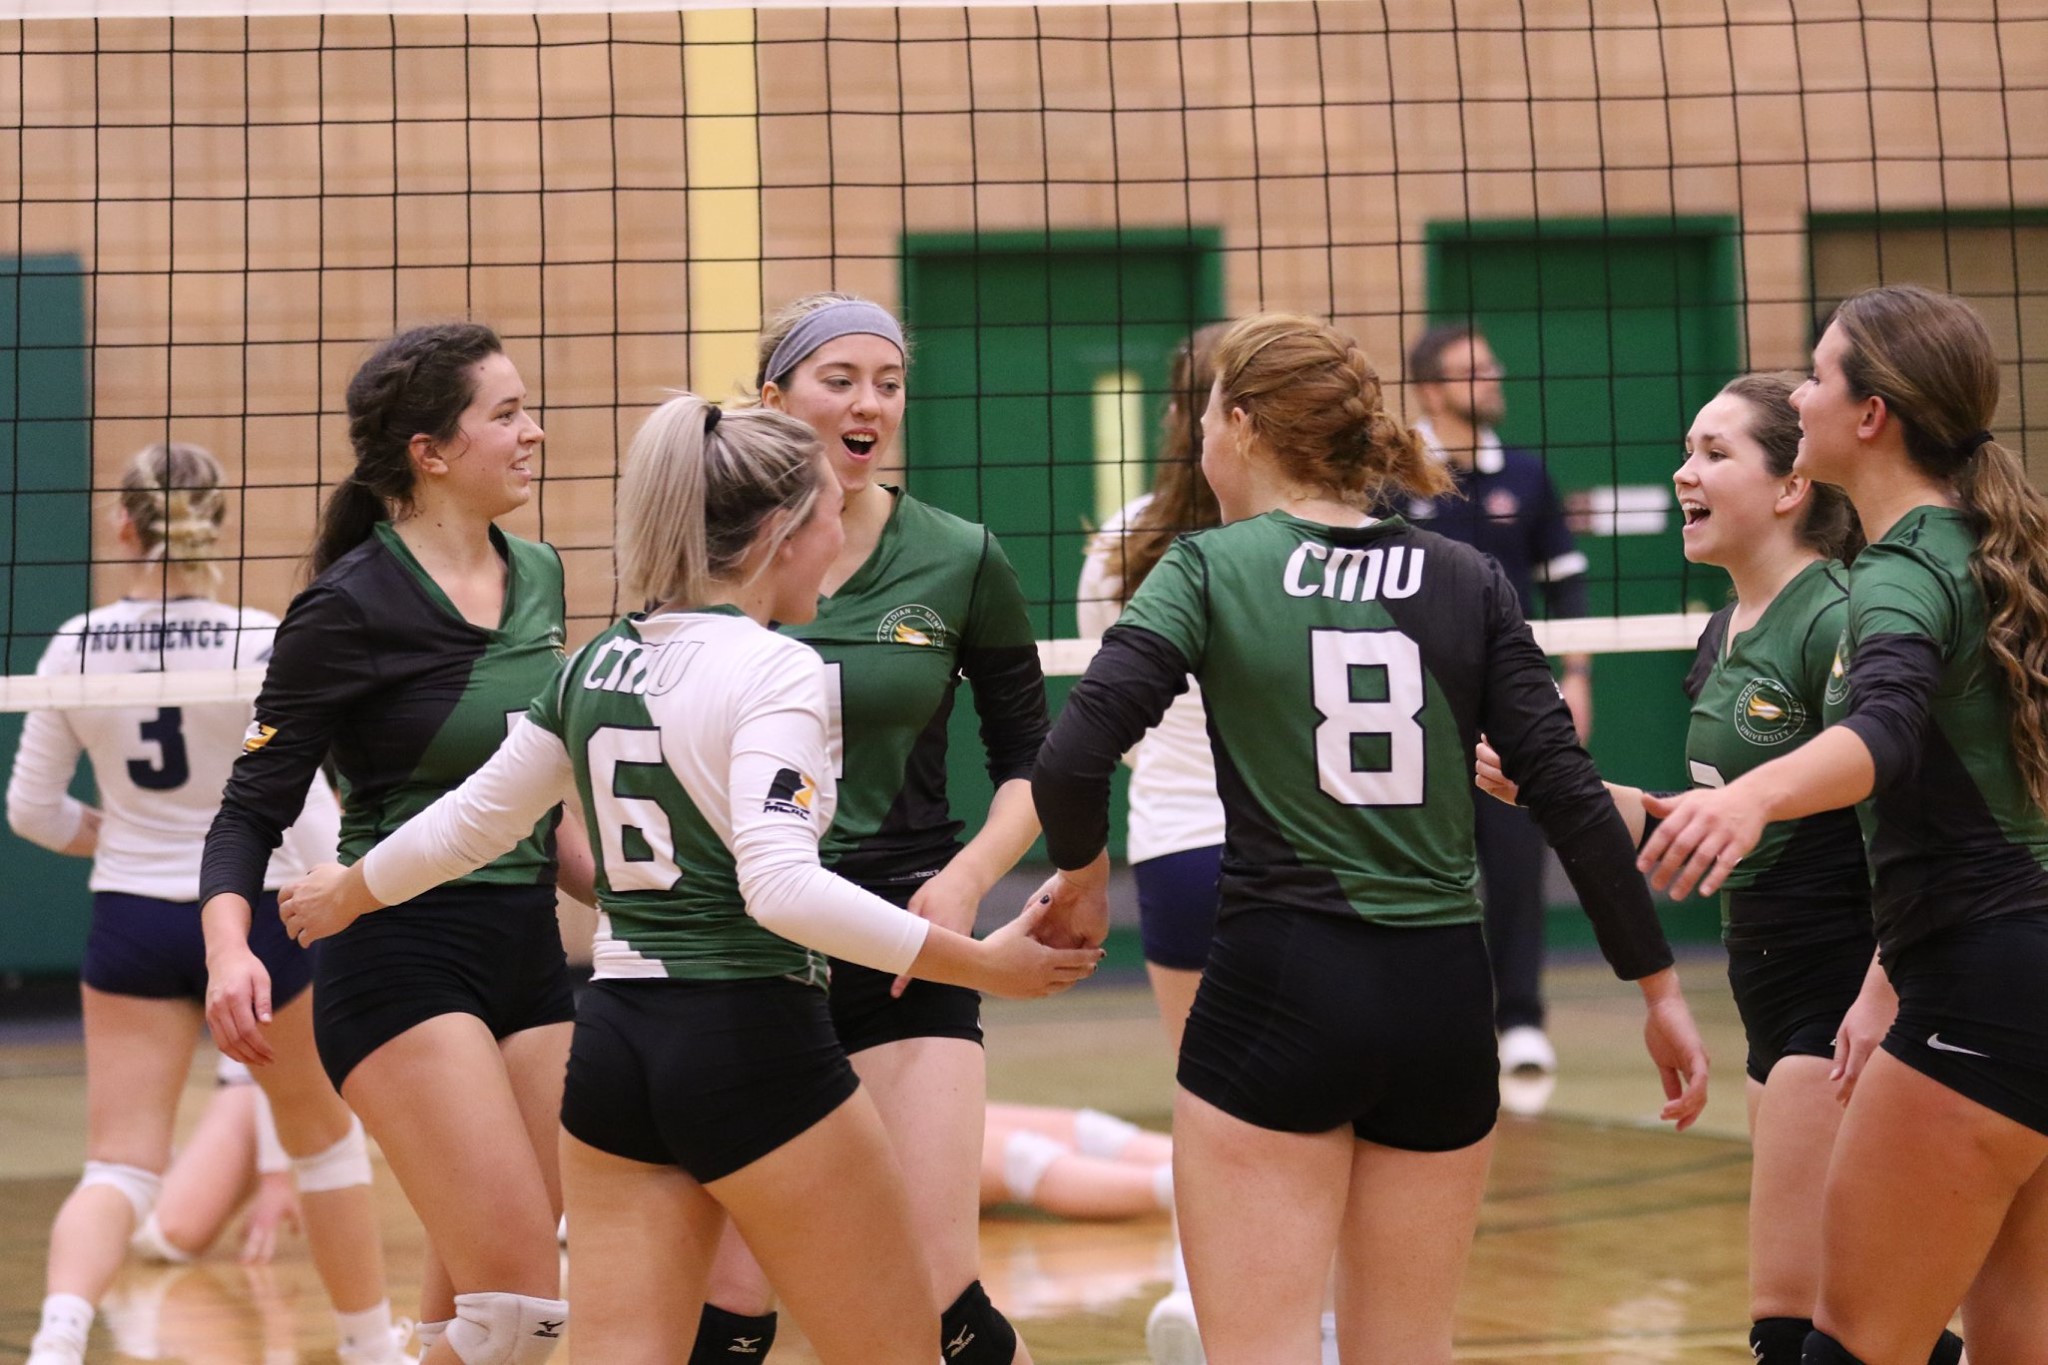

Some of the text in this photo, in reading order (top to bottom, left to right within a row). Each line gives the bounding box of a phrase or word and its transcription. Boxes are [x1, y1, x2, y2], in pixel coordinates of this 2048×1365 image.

[1283, 541, 1425, 602] CMU
[77, 620, 228, 652] PROVIDENCE
[880, 608, 911, 640] CANADIAN
[127, 705, 190, 791] 3
[1309, 626, 1426, 809] 8
[1740, 725, 1789, 742] UNIVERSITY
[586, 724, 684, 893] 6
